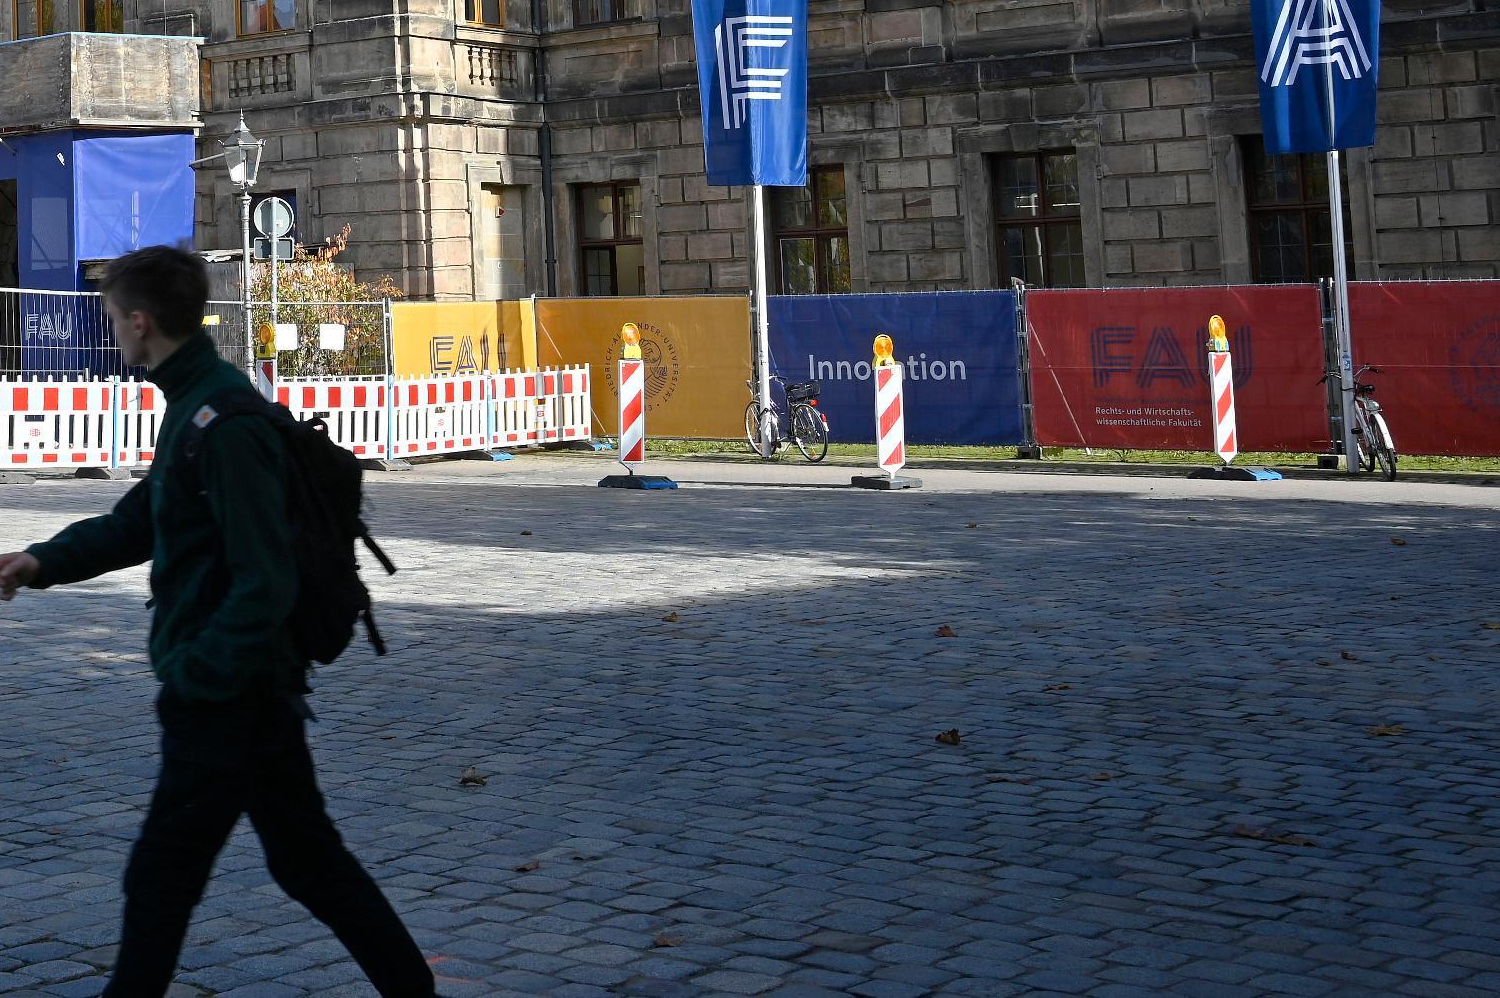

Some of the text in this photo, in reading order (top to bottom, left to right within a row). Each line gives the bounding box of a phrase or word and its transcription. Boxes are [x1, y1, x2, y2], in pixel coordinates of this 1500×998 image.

[25, 313, 73, 340] FAU
[809, 353, 967, 381] Innotion
[1091, 324, 1253, 390] FAU
[1095, 406, 1194, 416] Rechts- und Wirtschafts-
[1096, 417, 1202, 427] wissenschaftliche Fakultät
